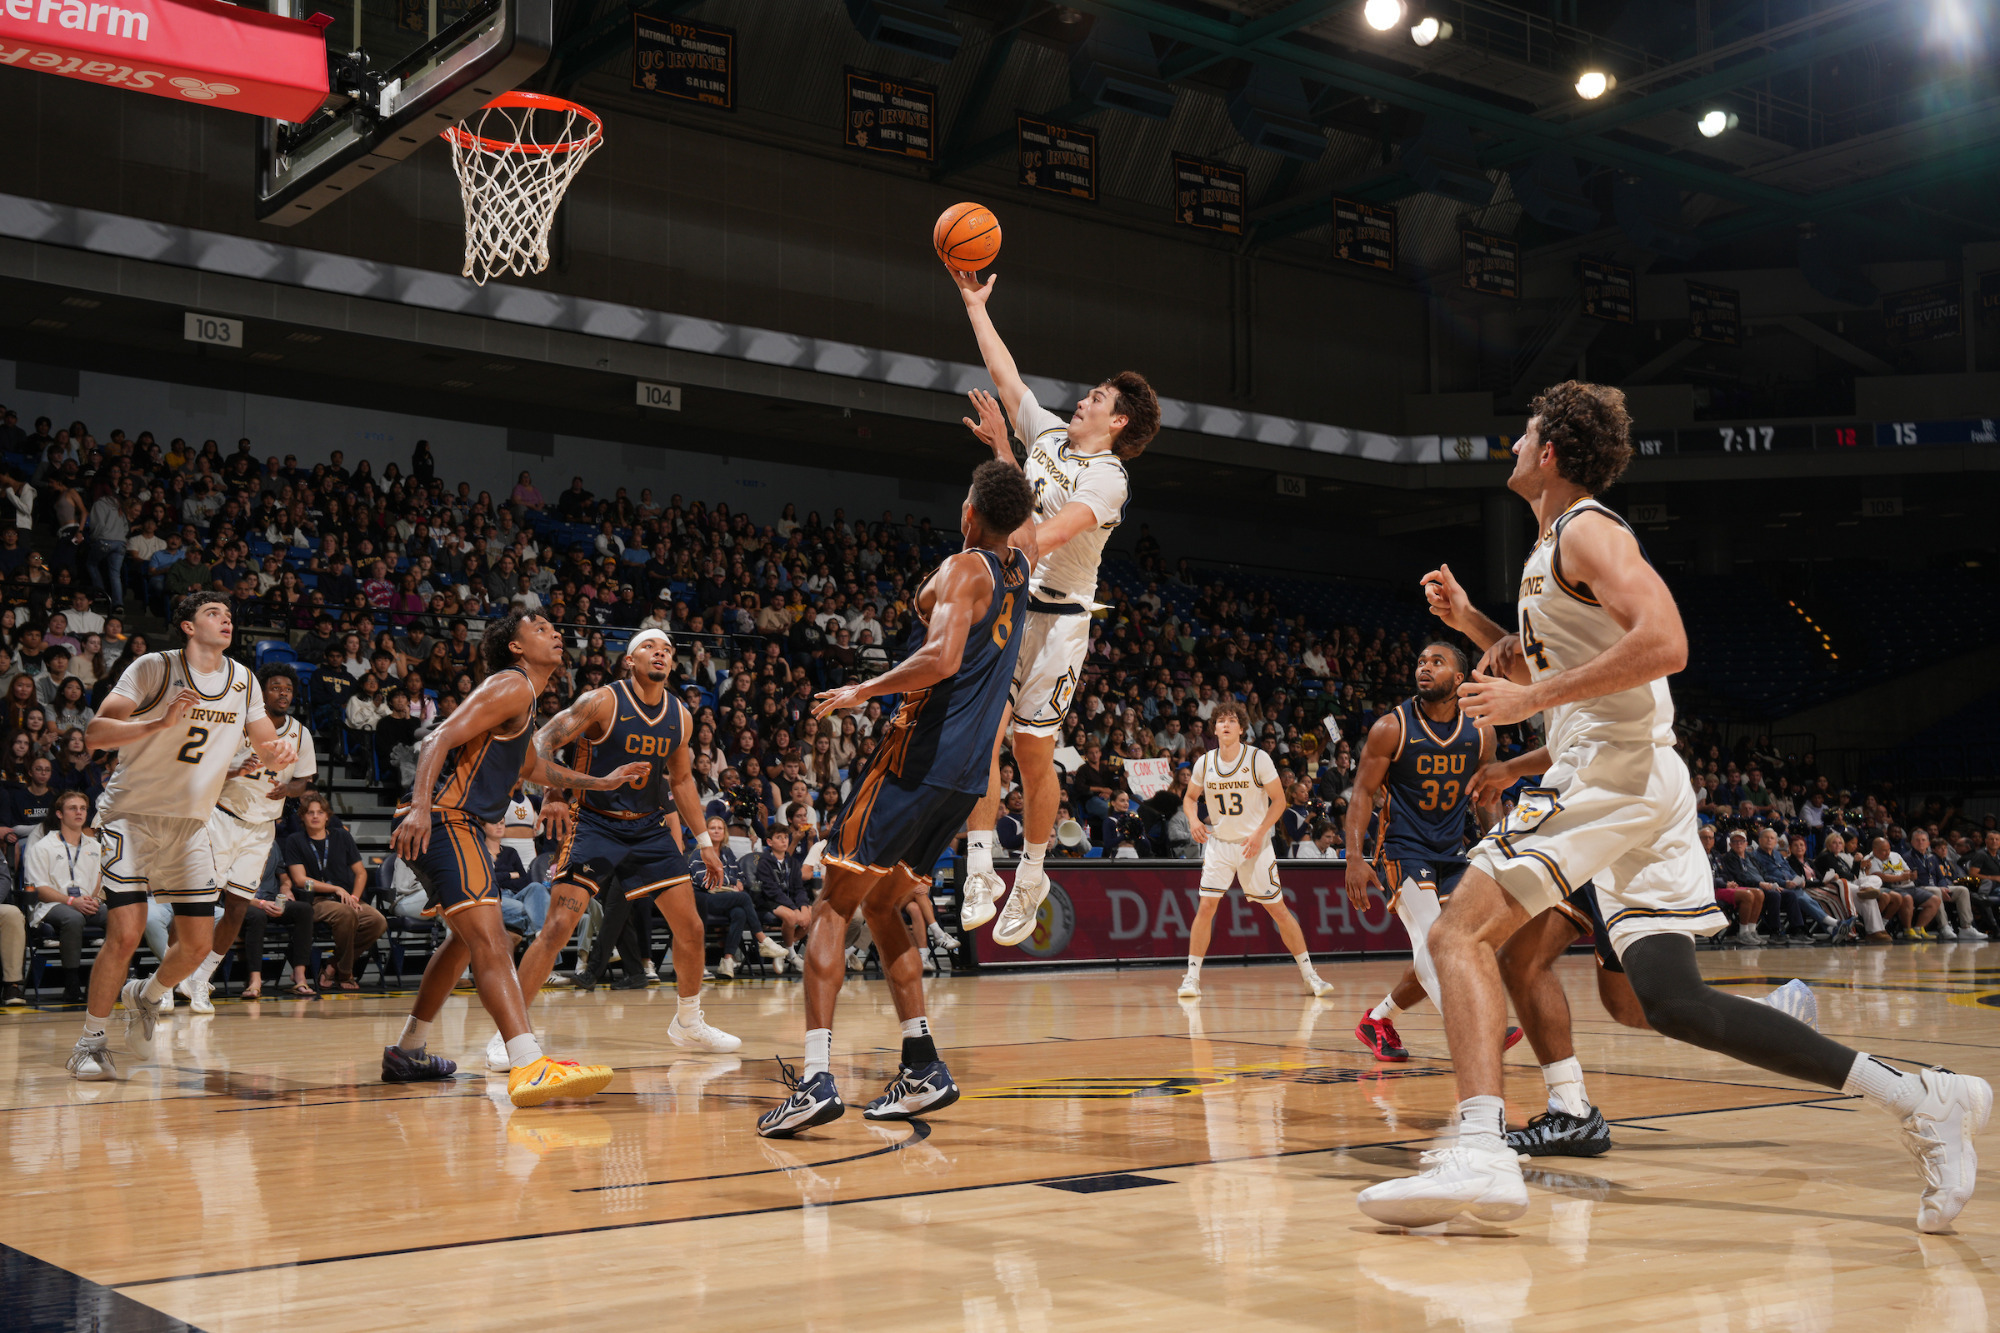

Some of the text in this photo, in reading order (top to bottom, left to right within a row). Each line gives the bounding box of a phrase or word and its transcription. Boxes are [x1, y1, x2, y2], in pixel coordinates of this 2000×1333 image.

[0, 0, 149, 41] eFarm
[669, 22, 696, 39] 1972
[638, 27, 726, 56] NATIONAL CHAMPIONS
[0, 43, 166, 89] StateF
[638, 49, 727, 72] UC IRVINE
[685, 76, 726, 93] SAILING
[879, 81, 904, 97] 1972
[852, 88, 928, 113] NATIONAL CHAMPIONS
[852, 108, 929, 129] UC IRVINE
[881, 128, 928, 148] MEN'S TENNIS
[1022, 130, 1089, 154] NATIONAL CHAMPIONS
[1047, 124, 1067, 140] 1973
[1023, 149, 1090, 169] UC IRVINE
[1055, 170, 1090, 187] BASEBALL
[1179, 188, 1240, 208] UC IRVINE
[1337, 226, 1391, 244] UC IRVINE
[1466, 257, 1482, 274] UC
[1885, 315, 1904, 329] UC
[1908, 304, 1958, 325] IRVINE
[196, 318, 231, 343] 103
[645, 385, 672, 407] 104
[1639, 440, 1663, 456] 1ST
[1719, 425, 1775, 452] 7:17
[1892, 422, 1918, 446] 15
[1282, 478, 1301, 494] 106
[1637, 507, 1658, 521] 107
[1870, 500, 1894, 514] 108
[992, 592, 1015, 650] 8
[1522, 607, 1550, 672] 4
[190, 708, 238, 724] IRVINE
[176, 725, 209, 765] 2
[624, 733, 672, 758] CBU
[1133, 761, 1154, 777] COOK
[1416, 754, 1467, 775] CBU
[1206, 780, 1250, 790] UC IRVINE
[1418, 779, 1460, 811] 33
[1214, 791, 1244, 816] 13
